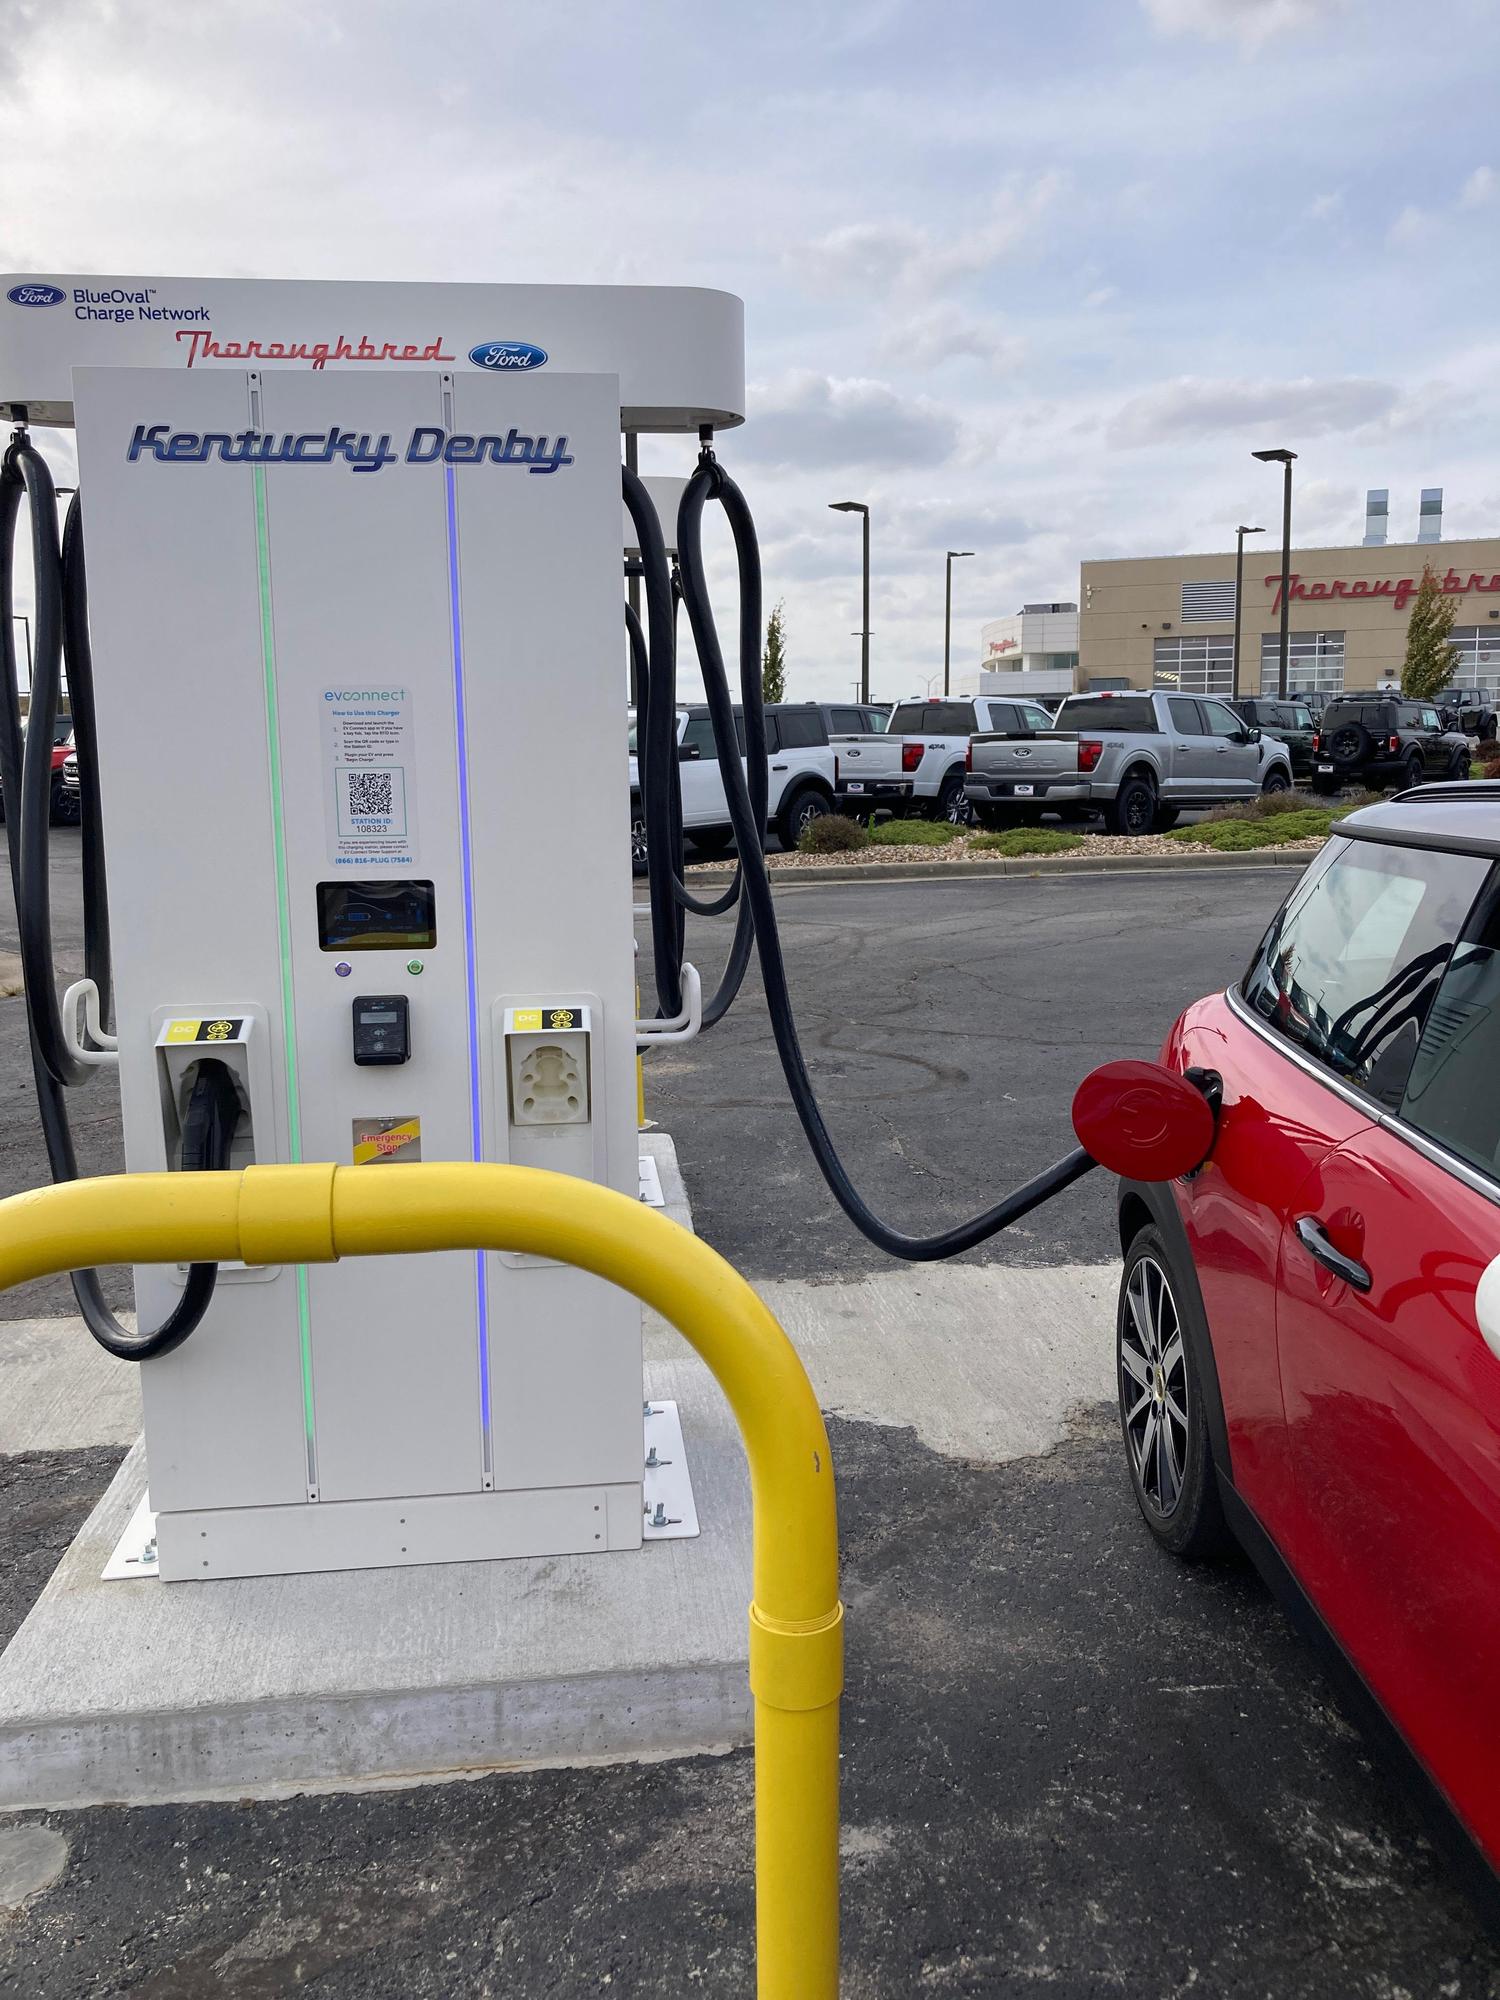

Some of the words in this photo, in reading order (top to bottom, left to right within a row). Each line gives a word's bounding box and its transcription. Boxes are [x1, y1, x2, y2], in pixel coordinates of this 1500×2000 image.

[75, 306, 134, 323] Charge
[139, 306, 210, 321] Network
[175, 330, 456, 370] Thoroughbred
[127, 424, 397, 473] Kentucky
[357, 825, 387, 833] 108323
[361, 1134, 411, 1143] Emergency
[377, 1144, 398, 1153] Stop
